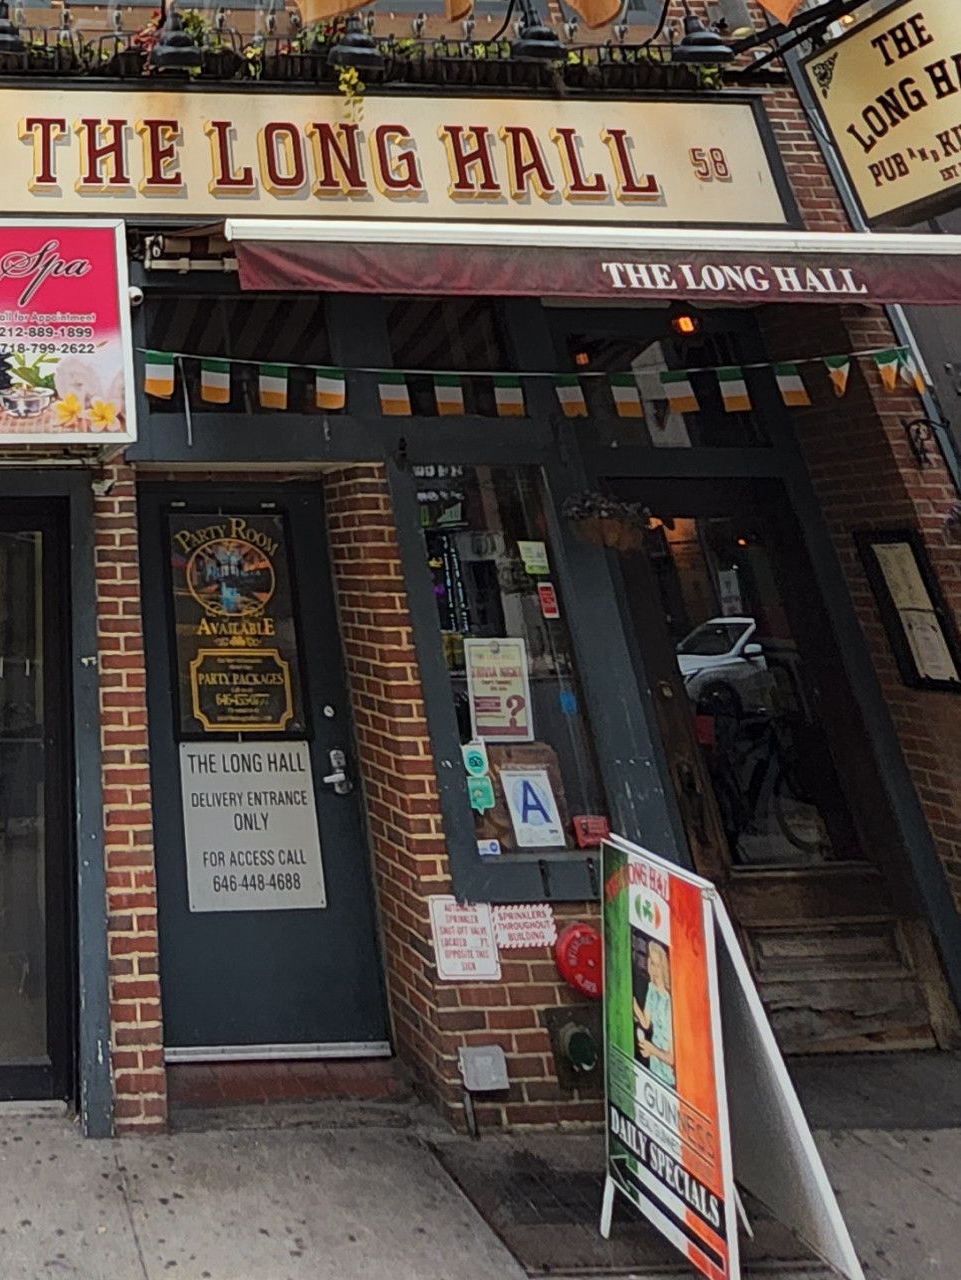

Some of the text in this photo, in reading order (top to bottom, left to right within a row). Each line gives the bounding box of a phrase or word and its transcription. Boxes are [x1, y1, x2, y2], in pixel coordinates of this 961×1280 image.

[871, 12, 935, 67] THE
[847, 76, 929, 154] LONG
[19, 116, 188, 198] THE
[206, 117, 427, 203] LONG
[438, 123, 668, 208] HALL
[688, 146, 732, 183] 58
[868, 152, 911, 188] PUB
[602, 261, 868, 295] THE LONG HALL
[14, 311, 28, 322] for
[31, 311, 96, 324] Appointment
[0, 342, 95, 354] 718-799-2622
[199, 672, 284, 686] PARTY PACKAGES
[188, 751, 306, 773] THE LONG HALL
[191, 790, 309, 808] DELIVERY ENTRANCE
[521, 779, 553, 824] A
[234, 812, 270, 832] ONLY
[203, 848, 307, 868] FOR ACCESS CALL
[498, 909, 547, 921] SPRINKLERS
[498, 920, 550, 931] THROUGHOUT
[507, 931, 545, 942] BUILDING
[610, 1106, 649, 1162] DAILY
[649, 1141, 721, 1228] SPECIALS
